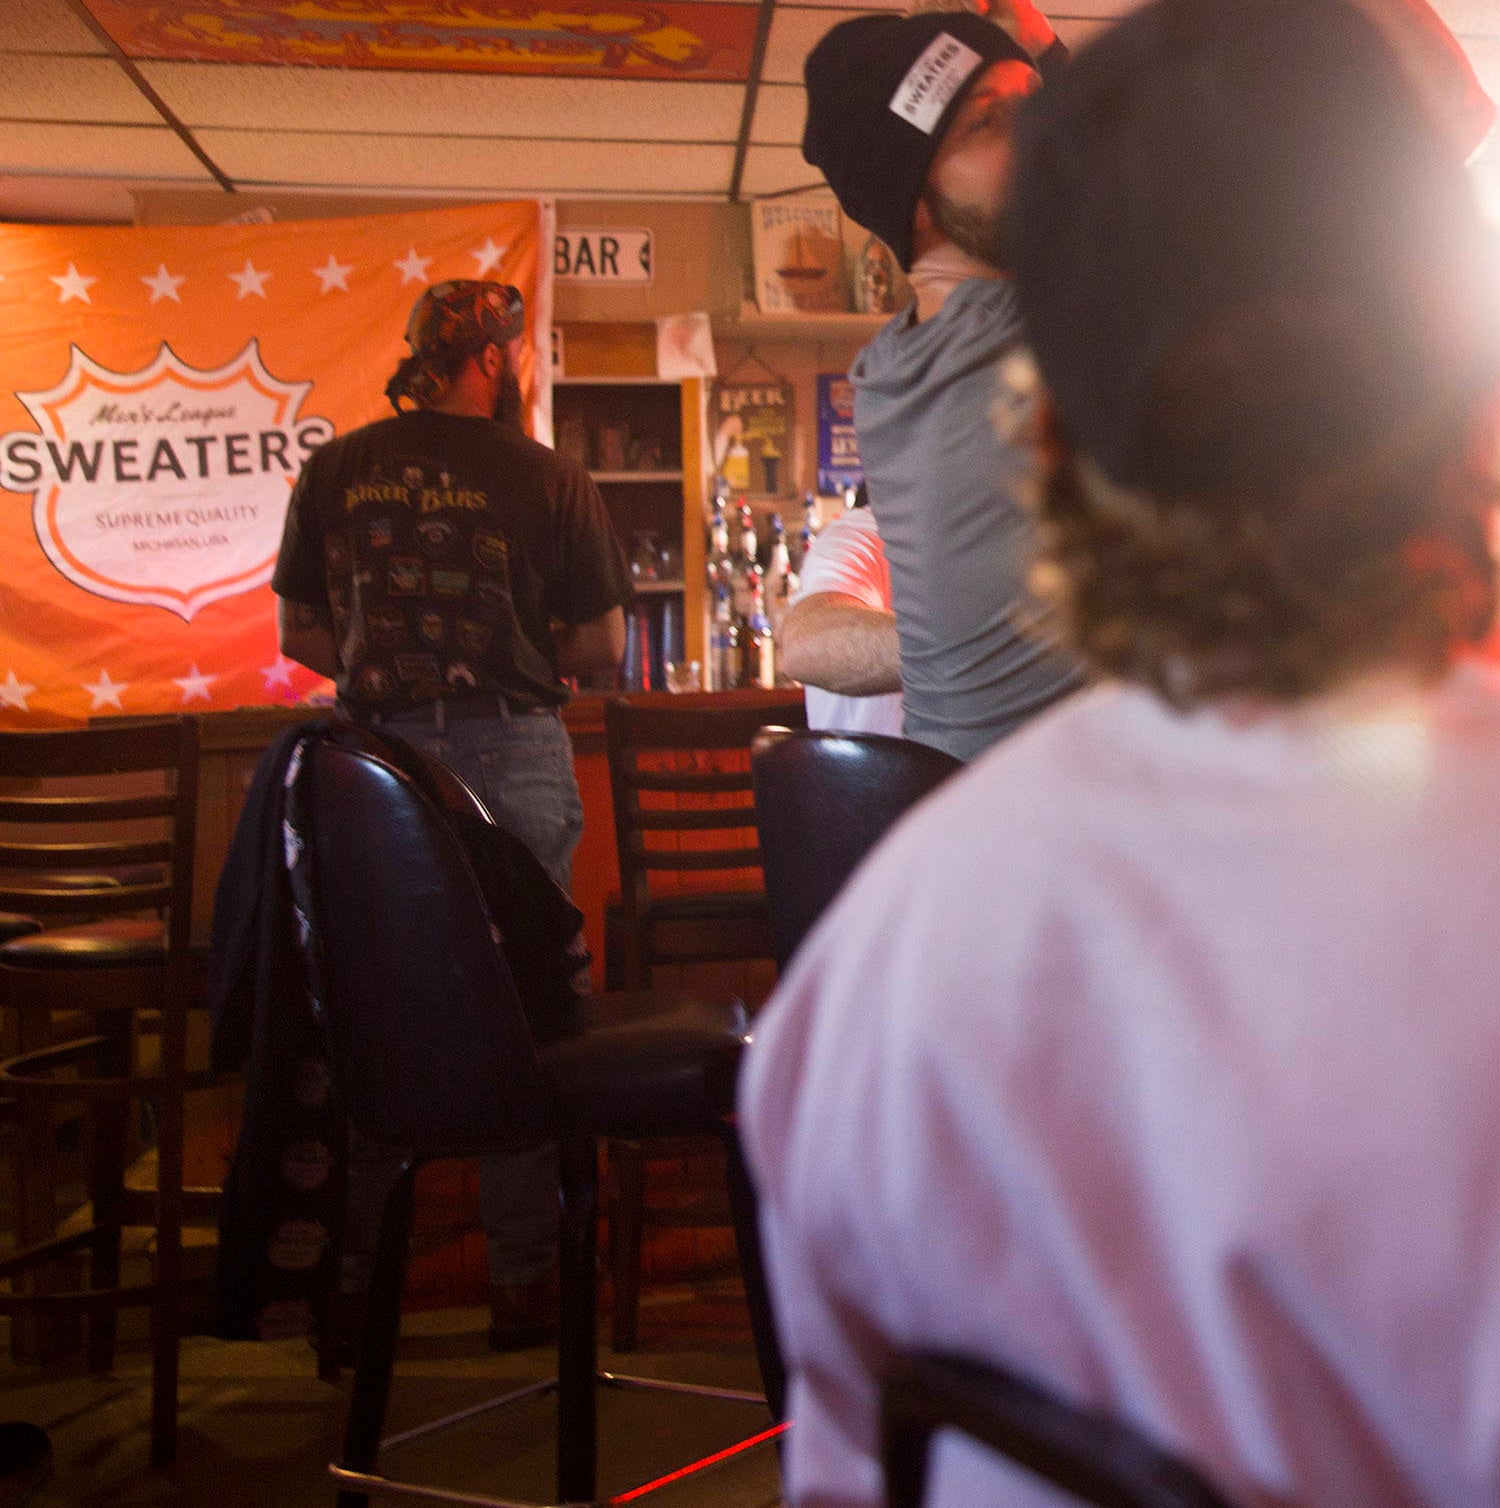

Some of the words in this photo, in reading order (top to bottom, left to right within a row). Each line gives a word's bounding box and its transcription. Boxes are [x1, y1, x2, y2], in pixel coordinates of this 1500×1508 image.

[903, 43, 959, 114] SWEATERS
[553, 236, 620, 276] BAR
[6, 427, 326, 484] SWEATERS
[95, 511, 182, 529] SUPREME
[188, 505, 259, 527] QUALITY
